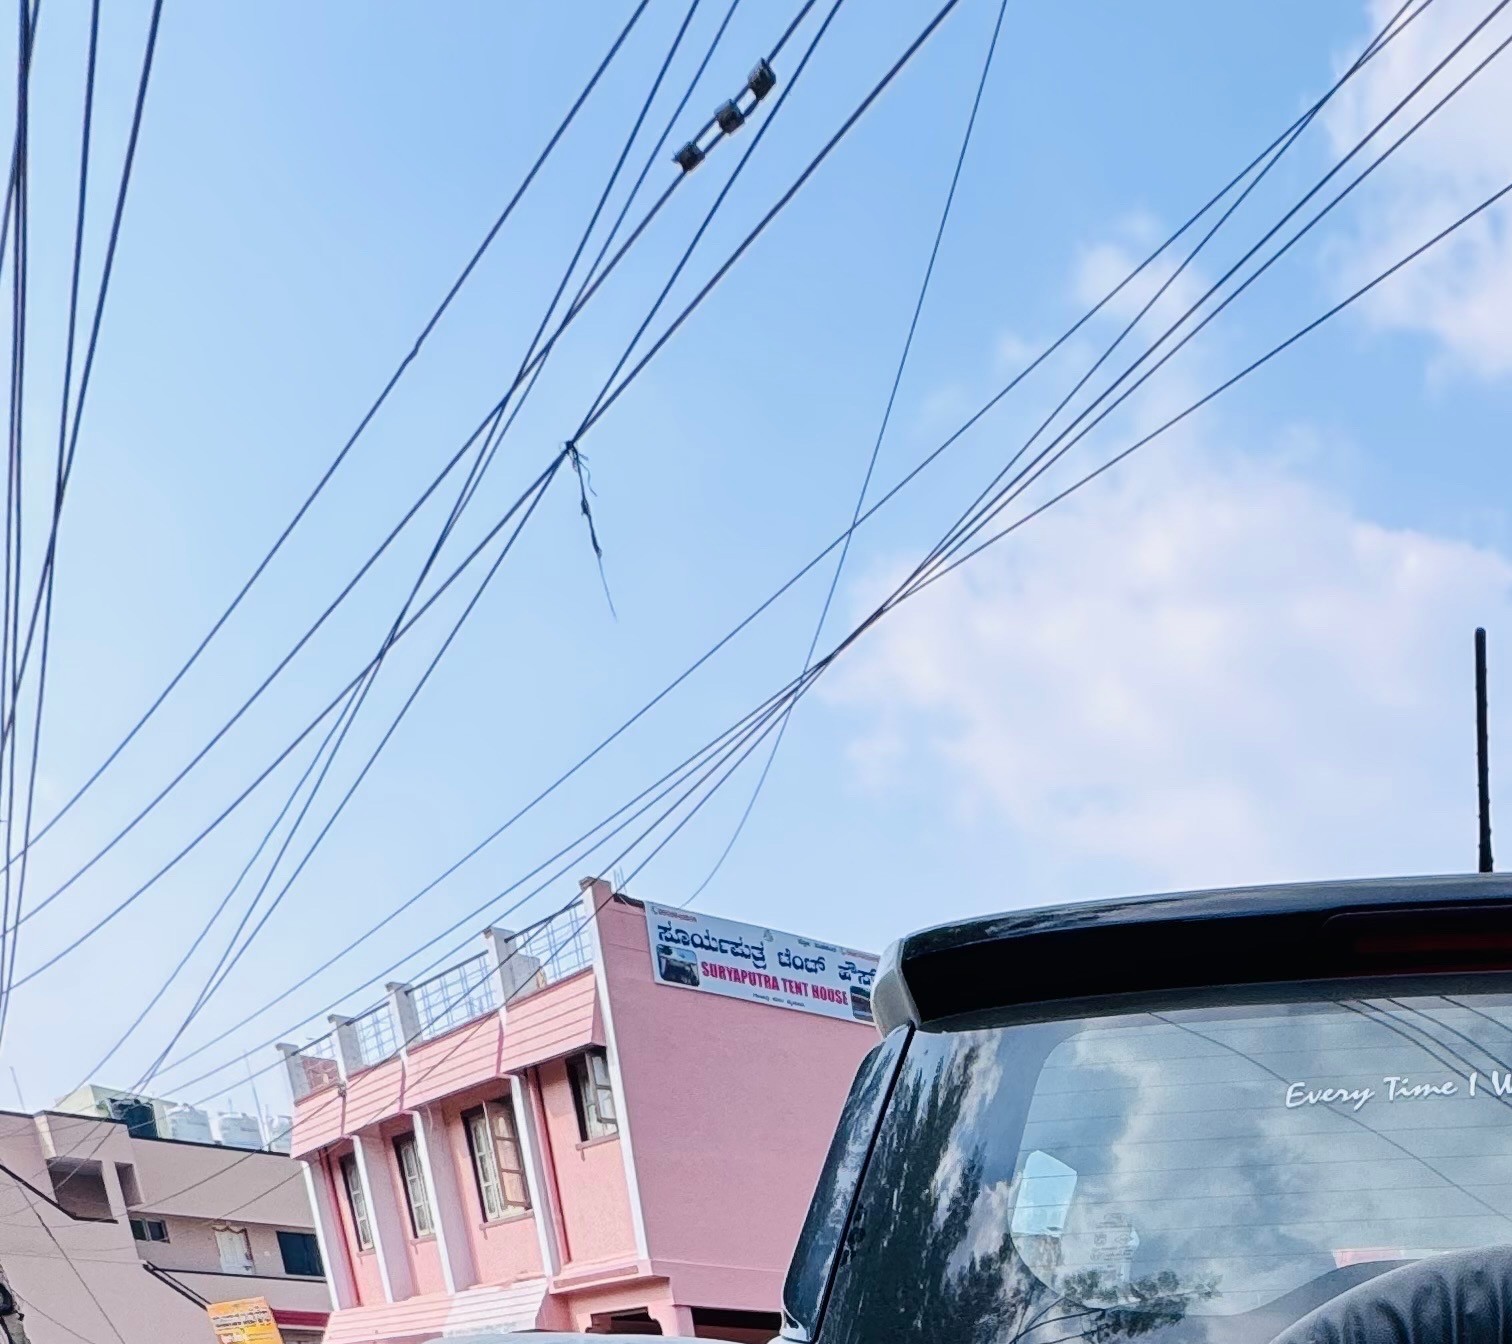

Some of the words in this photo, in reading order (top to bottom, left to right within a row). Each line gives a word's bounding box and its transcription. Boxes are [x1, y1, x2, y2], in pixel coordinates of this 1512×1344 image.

[777, 948, 826, 974] ಟೆಂಟ್
[701, 961, 780, 991] SURYAPUTRA
[781, 978, 809, 997] TENT
[811, 984, 849, 1006] HOUSE
[1285, 1080, 1376, 1111] Every
[1383, 1075, 1458, 1102] Time
[1469, 1071, 1479, 1096] I
